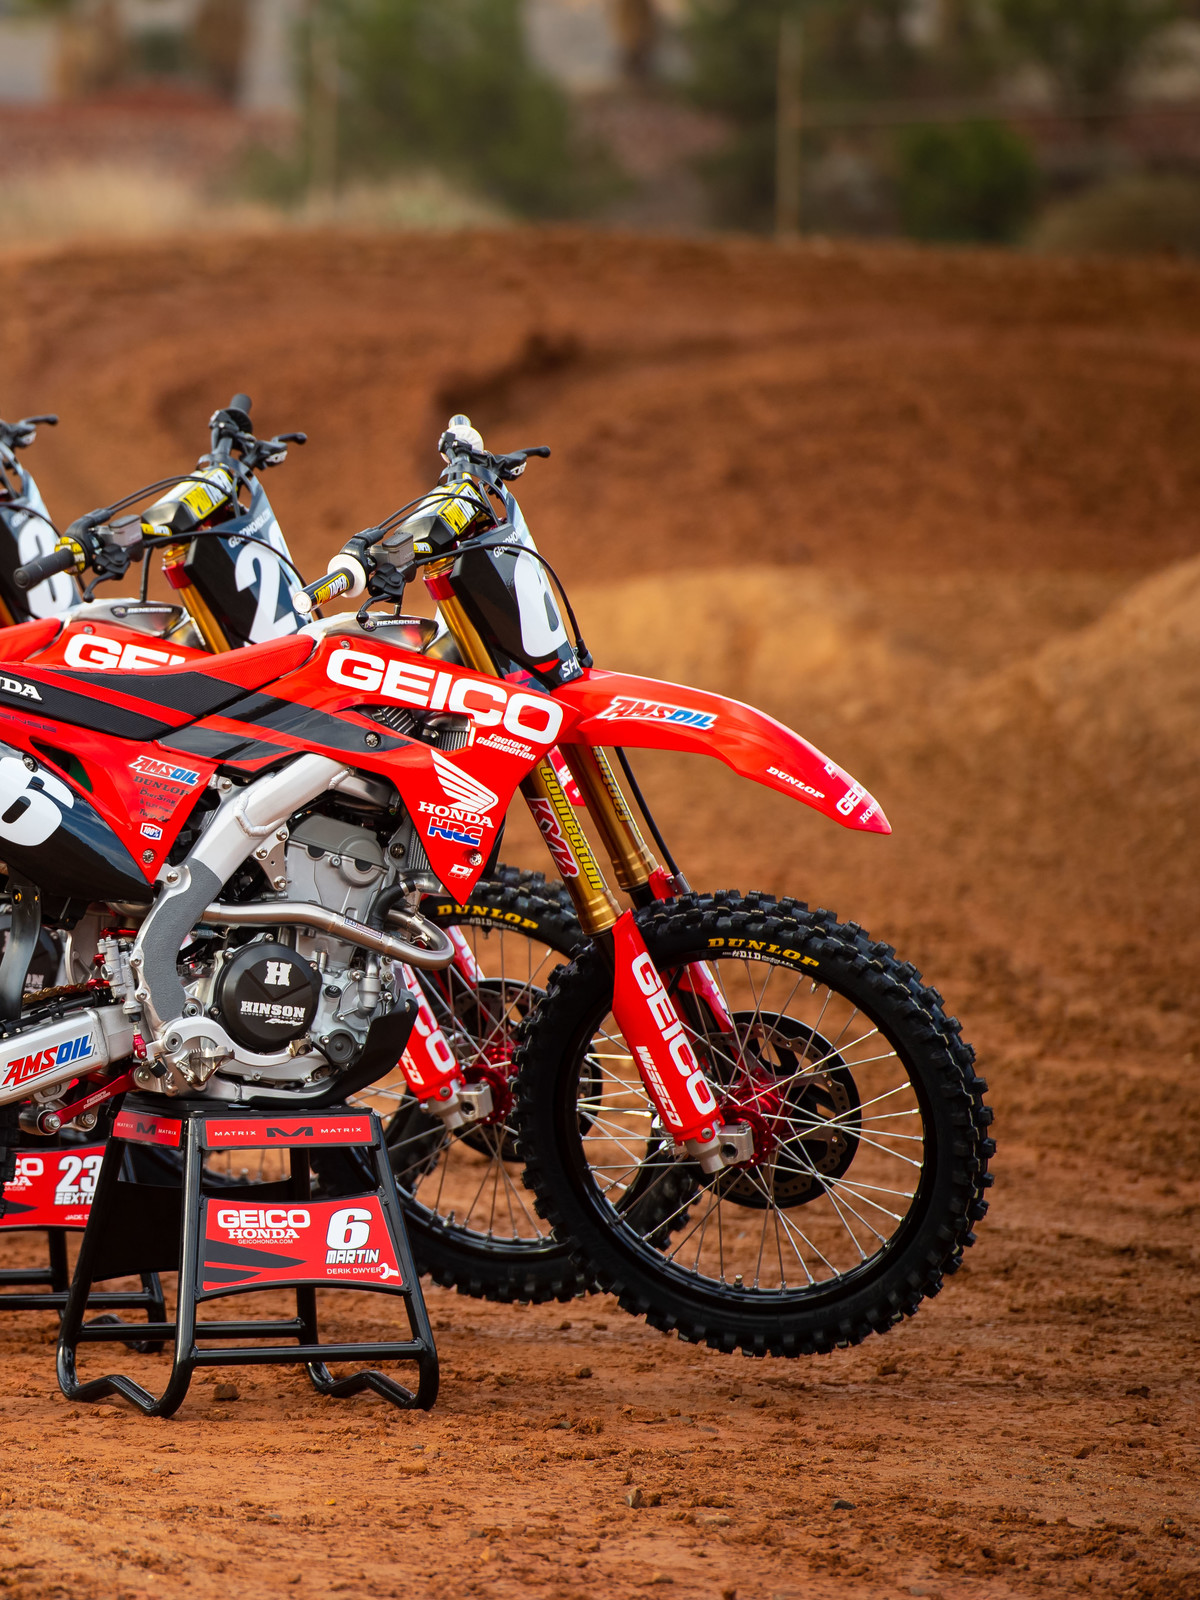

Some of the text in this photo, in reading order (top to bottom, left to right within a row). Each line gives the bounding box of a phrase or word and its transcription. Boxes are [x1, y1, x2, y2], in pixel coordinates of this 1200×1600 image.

[326, 649, 563, 744] GEICO
[596, 696, 718, 730] AMSOIL
[129, 755, 200, 786] AMSOIL
[767, 766, 825, 799] DUNLOP
[418, 801, 495, 828] HONDA
[427, 816, 484, 847] HRC
[437, 904, 539, 930] DUNLOP
[707, 937, 820, 967] DUNLOP
[240, 1000, 306, 1018] HINSON
[631, 952, 717, 1115] GEICO
[636, 1046, 684, 1127] WISECO
[55, 1155, 104, 1192] 23
[53, 1192, 95, 1205] SEXTO
[217, 1209, 311, 1228] GEICO
[228, 1228, 300, 1239] HONDA
[326, 1208, 373, 1250] 6
[325, 1249, 380, 1264] MARTIN
[326, 1266, 383, 1275] DERIK DWYER
